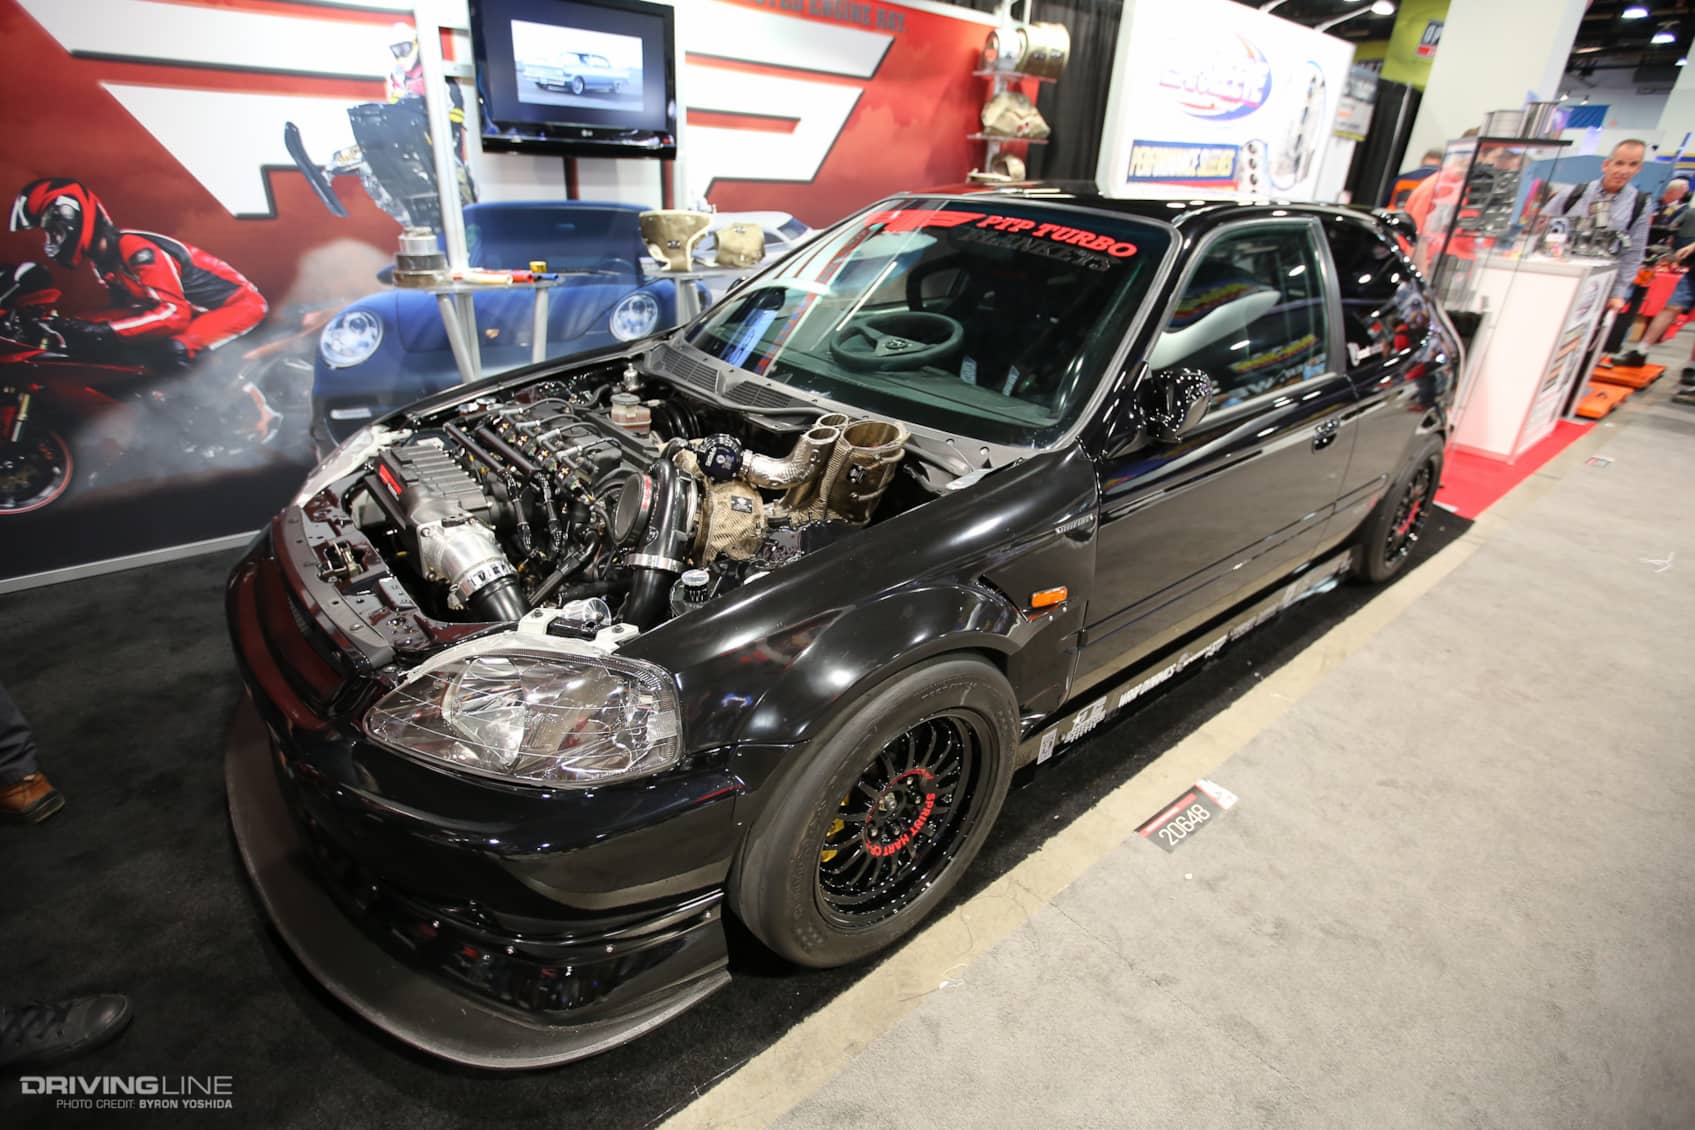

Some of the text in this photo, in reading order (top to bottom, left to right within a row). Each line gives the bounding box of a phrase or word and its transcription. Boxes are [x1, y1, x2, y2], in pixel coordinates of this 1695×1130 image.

[976, 215, 1138, 258] PTP TURBO
[909, 792, 937, 837] SPRINT
[1158, 803, 1211, 846] 20648
